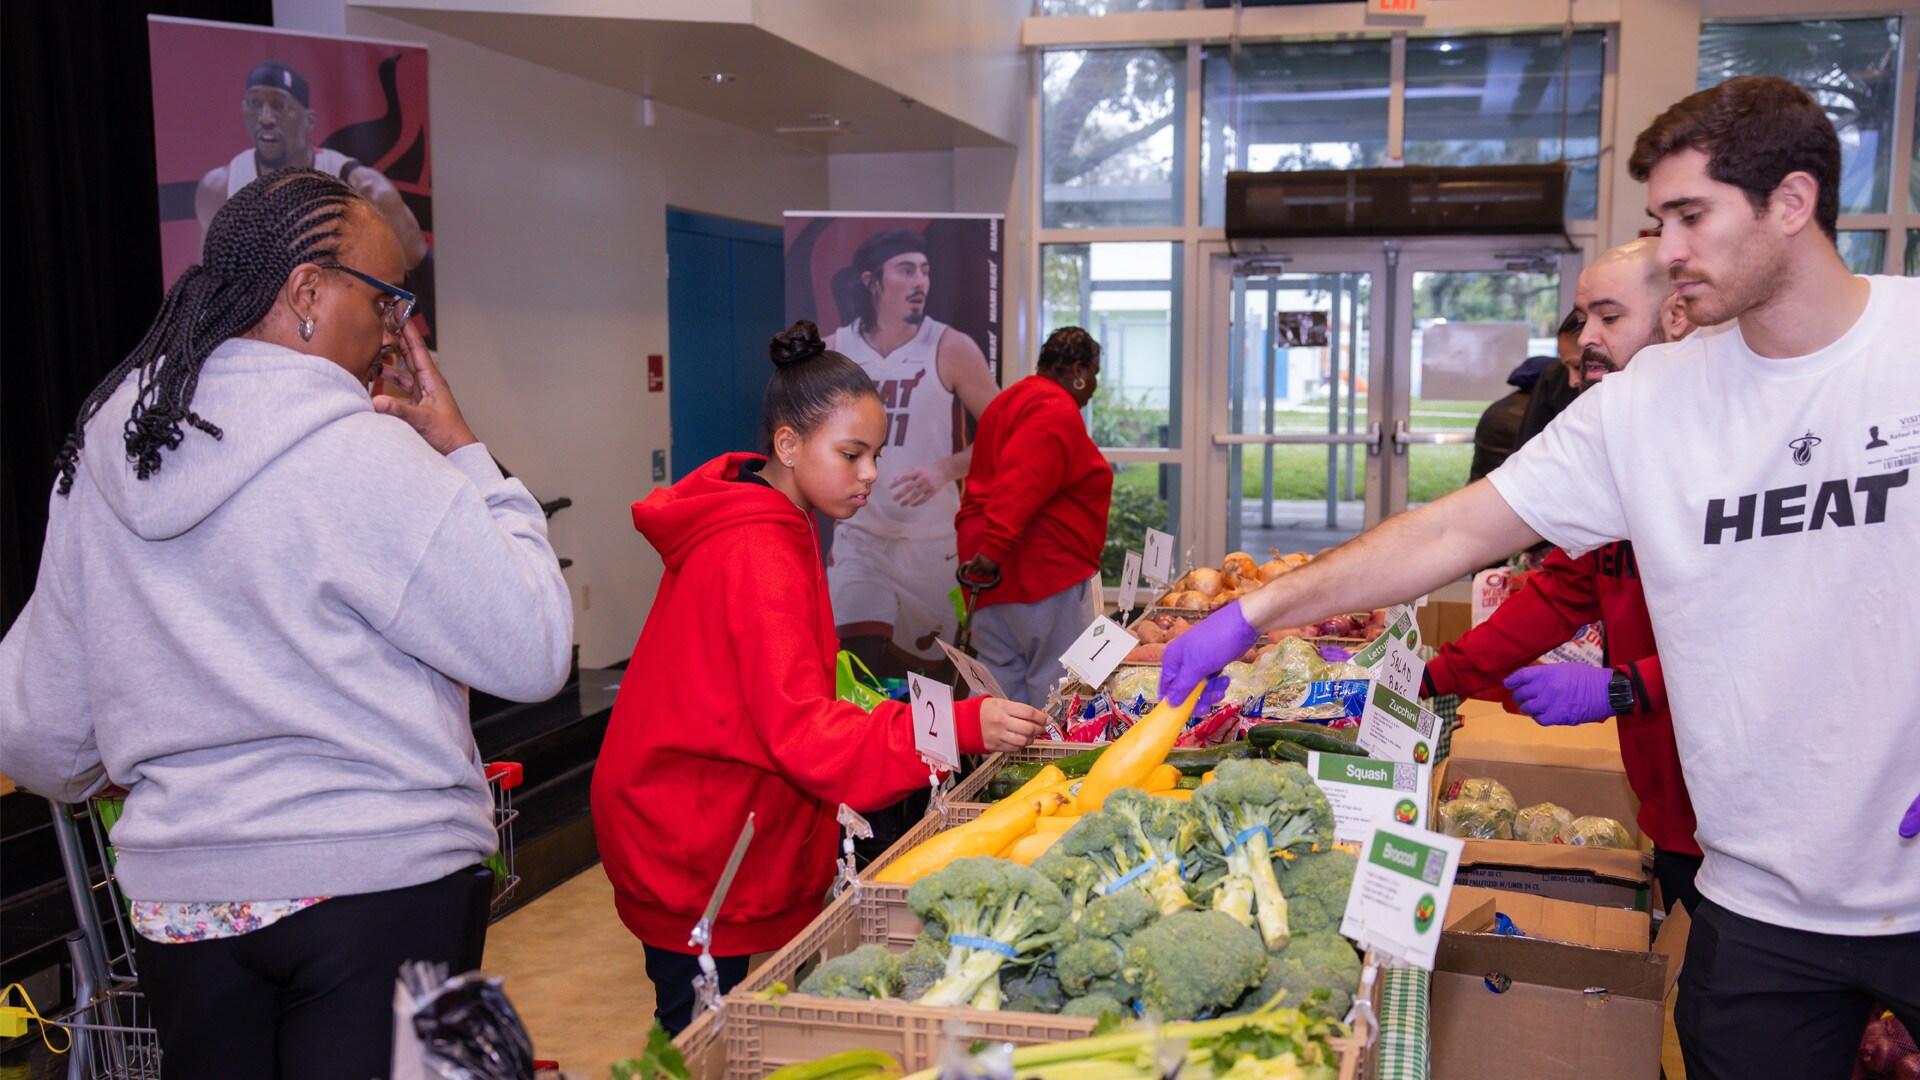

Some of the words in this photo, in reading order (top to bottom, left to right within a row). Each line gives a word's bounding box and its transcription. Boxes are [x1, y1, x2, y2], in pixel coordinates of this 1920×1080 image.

[987, 259, 998, 289] HEAT
[989, 290, 998, 323] MIAMI
[1703, 468, 1910, 545] HEAT
[1088, 639, 1111, 661] 1
[1390, 650, 1412, 683] SALAD
[926, 700, 938, 737] 2
[1388, 698, 1418, 724] Zucchini
[1346, 763, 1388, 782] Squash
